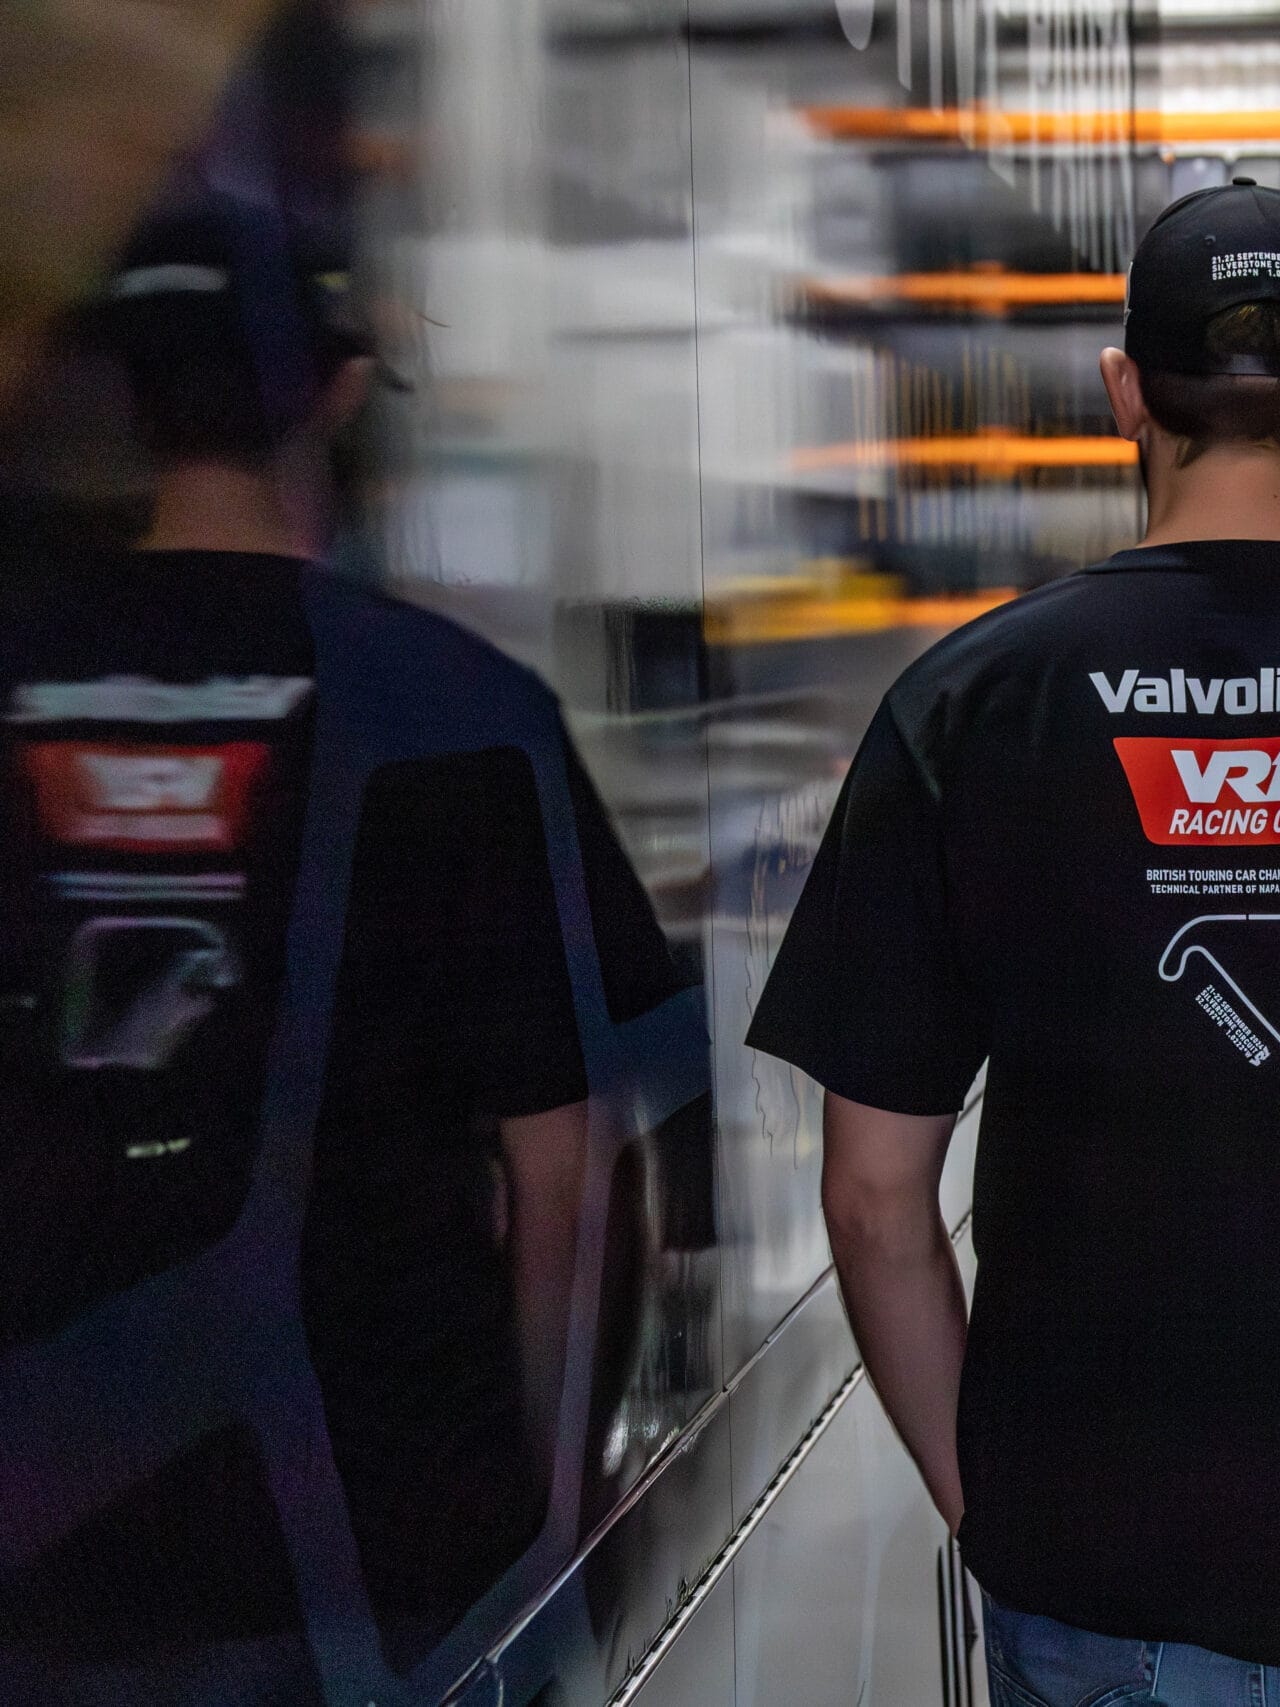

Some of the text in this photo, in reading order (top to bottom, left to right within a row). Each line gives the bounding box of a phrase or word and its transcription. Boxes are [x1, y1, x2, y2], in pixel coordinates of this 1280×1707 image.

[1212, 260, 1272, 272] SILVERSTONE
[1169, 808, 1268, 835] RACING
[1146, 869, 1186, 881] BRITISH
[1188, 869, 1233, 881] TOURING
[1235, 868, 1257, 881] CAR
[1151, 884, 1200, 894] TECHNICAL
[1202, 884, 1243, 894] PARTNER
[1245, 884, 1257, 894] OF
[1259, 884, 1280, 893] NAPA
[1200, 990, 1259, 1054] SILVERSTONE CIRCUIT
[1221, 1001, 1252, 1037] SEPTEMBER
[1250, 1034, 1265, 1050] 2024
